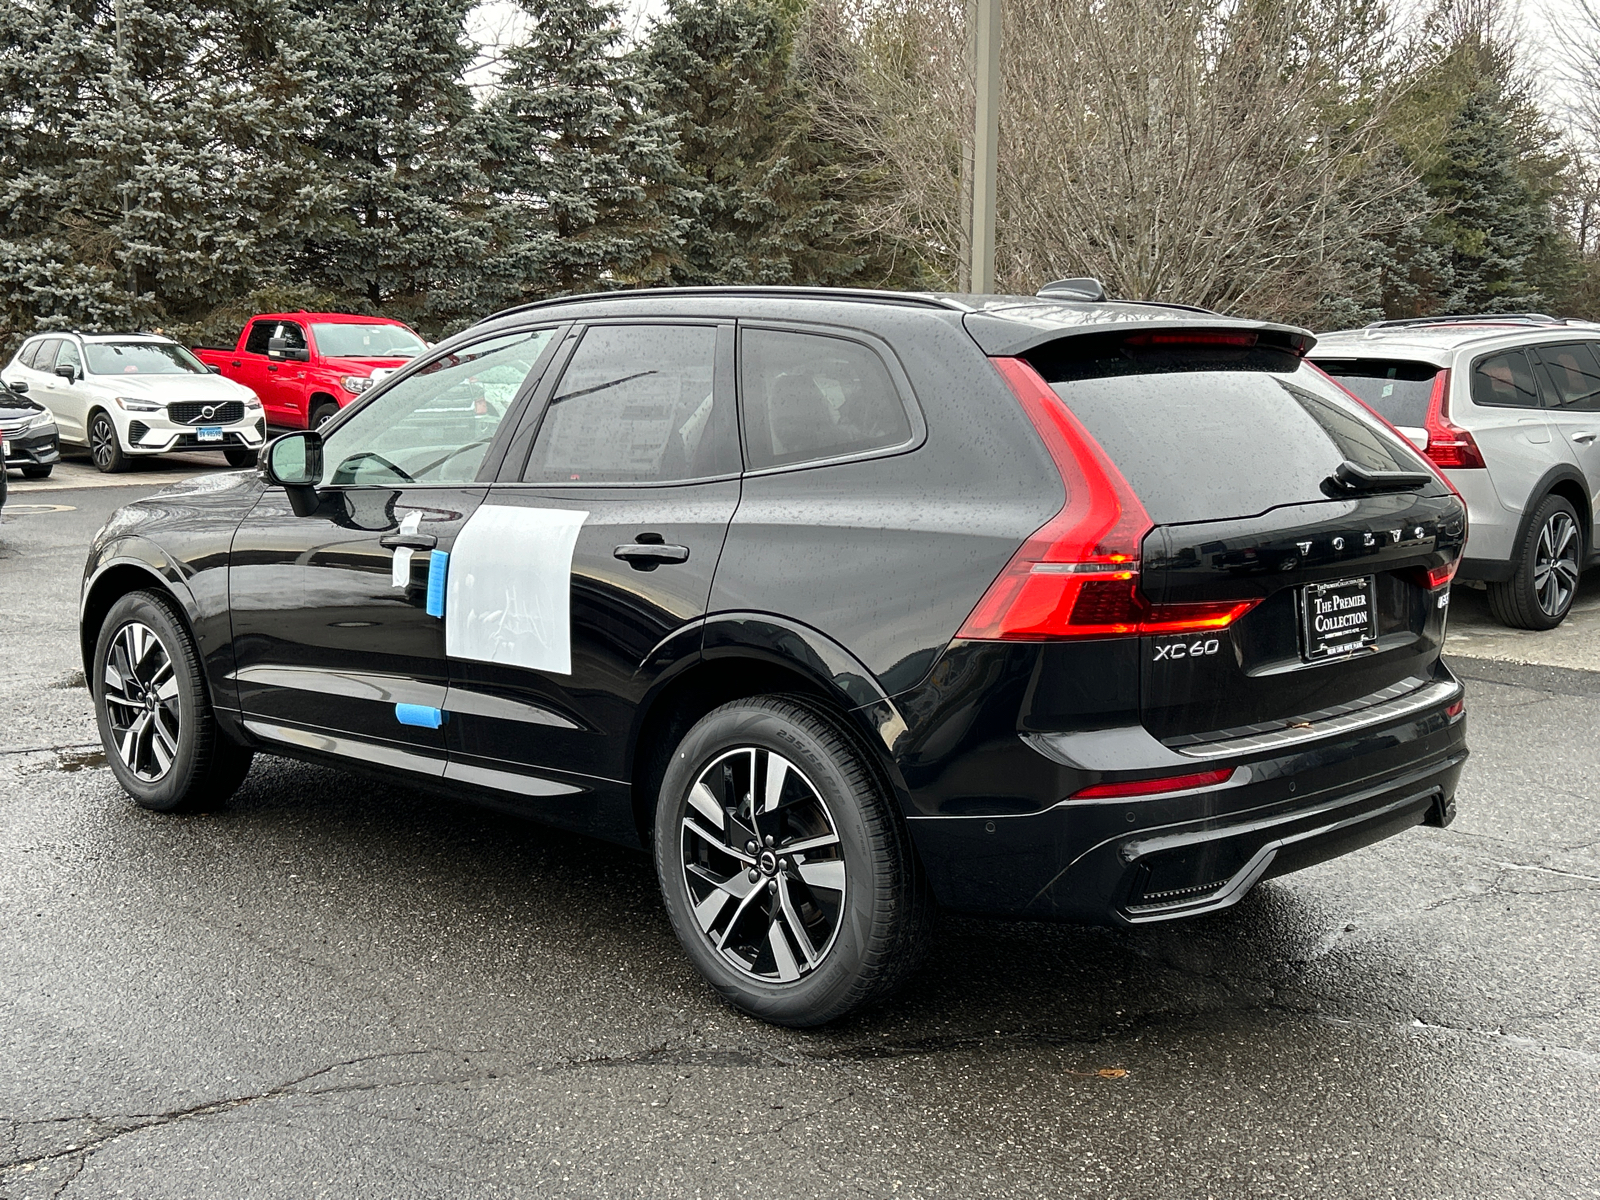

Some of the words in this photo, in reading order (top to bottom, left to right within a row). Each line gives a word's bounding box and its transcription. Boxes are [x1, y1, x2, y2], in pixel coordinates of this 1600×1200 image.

[1296, 526, 1425, 556] VOLVO
[1314, 597, 1333, 614] THE
[1332, 594, 1367, 611] PREMIER
[1315, 611, 1368, 632] COLLECTION
[1152, 639, 1219, 662] XC60
[776, 729, 826, 772] 235/55
